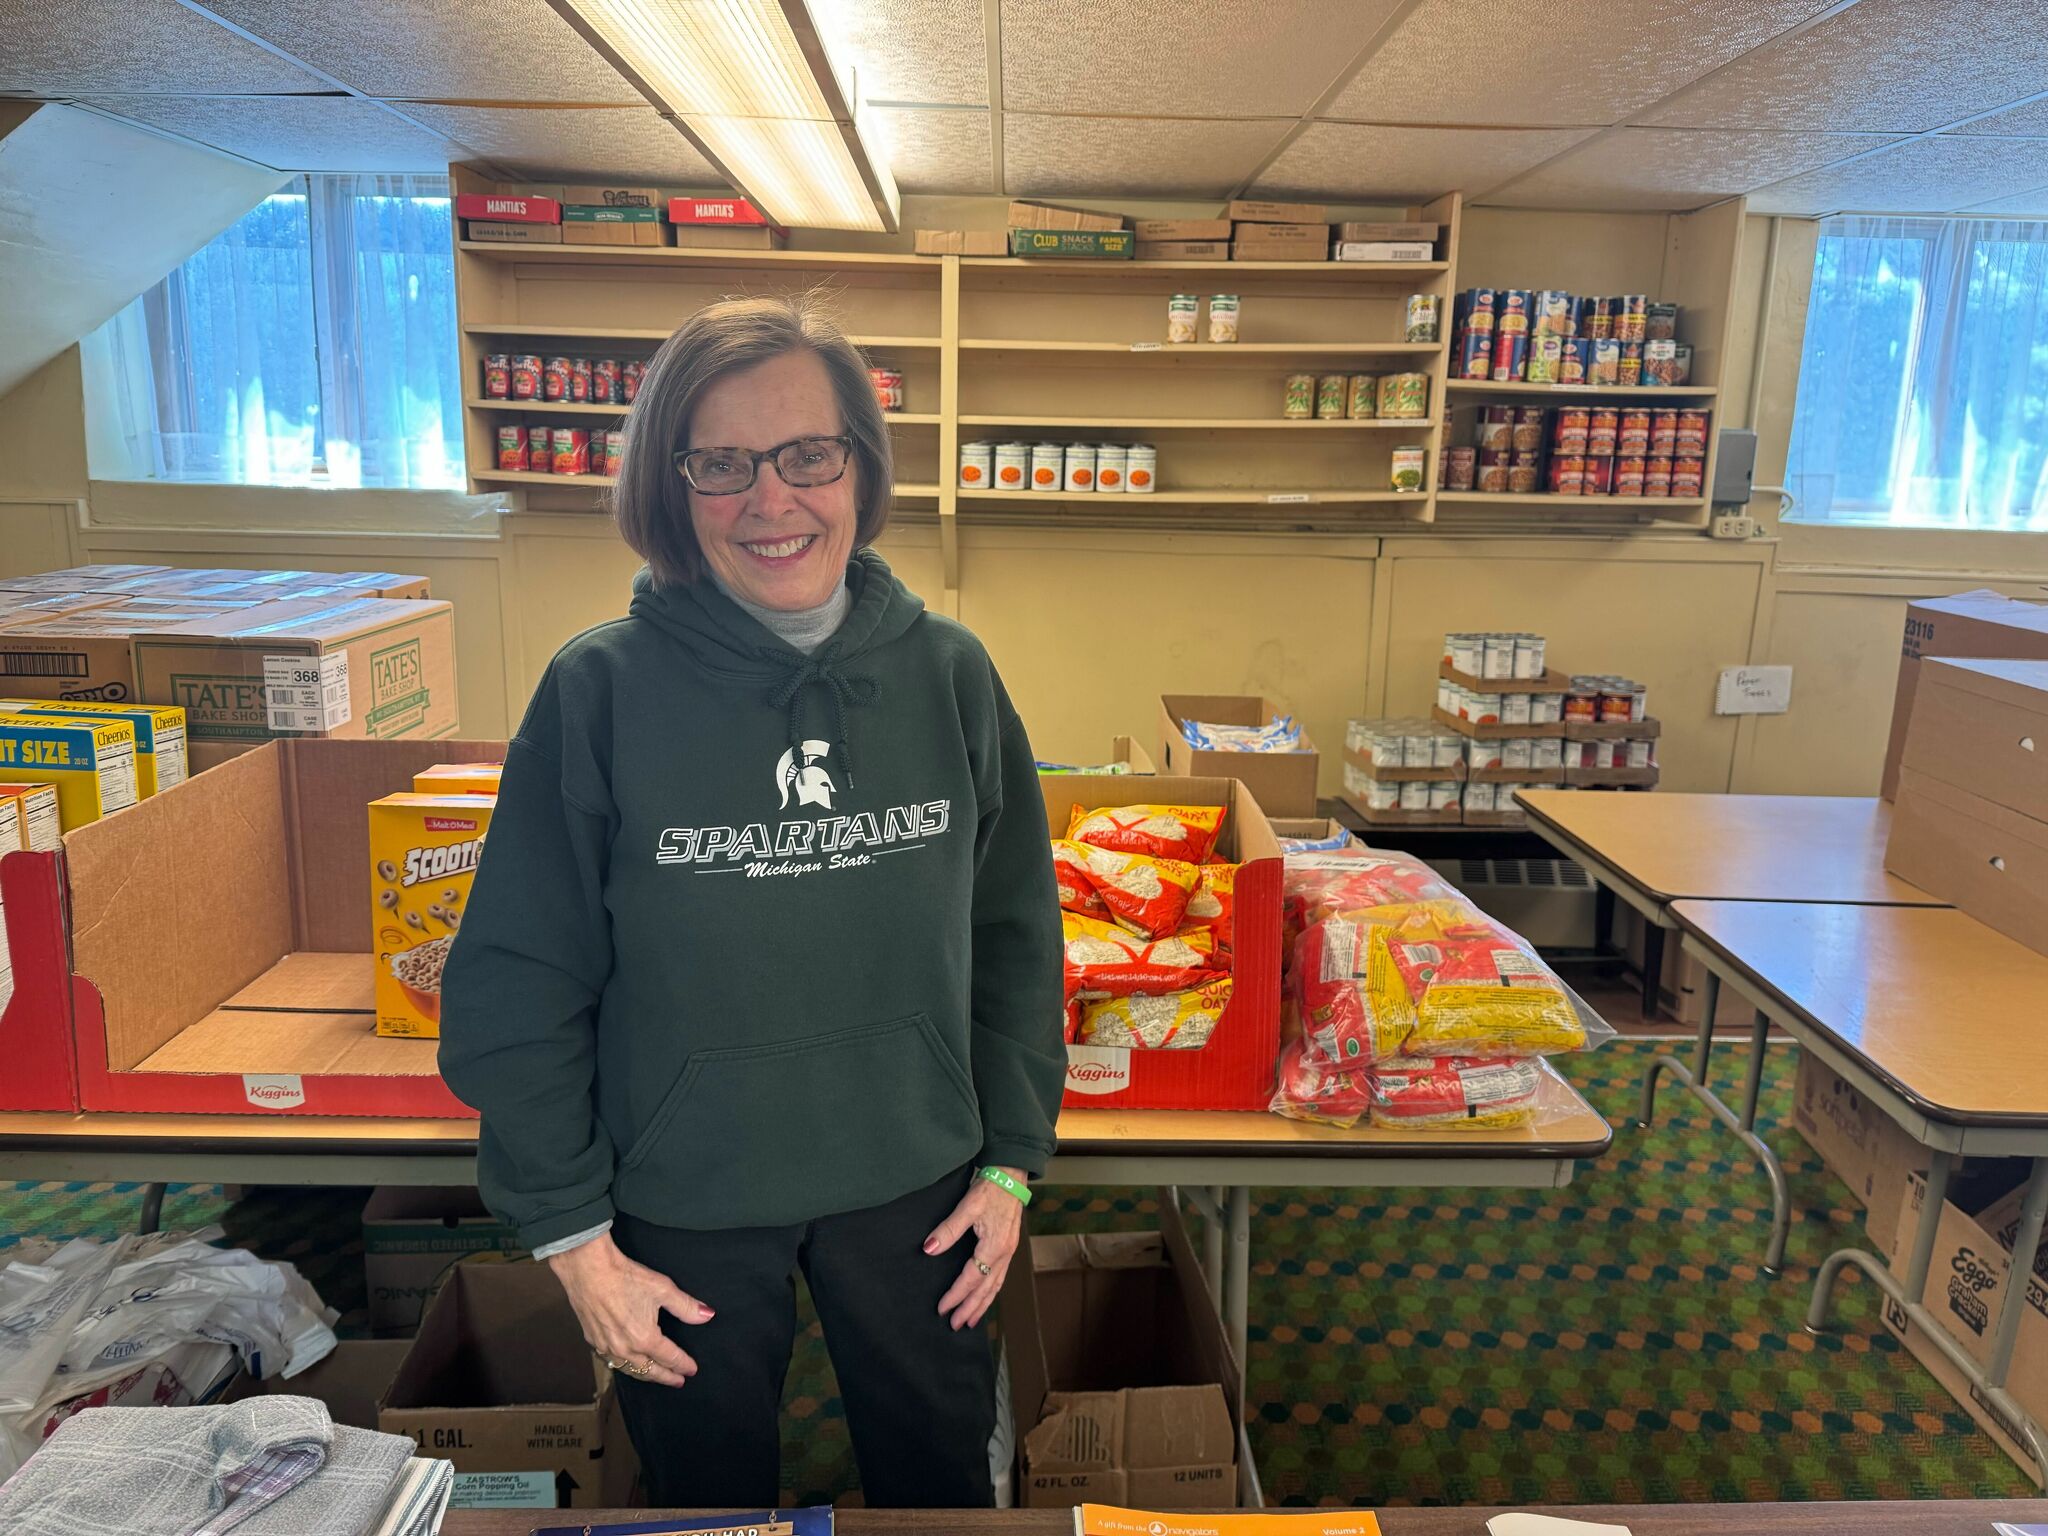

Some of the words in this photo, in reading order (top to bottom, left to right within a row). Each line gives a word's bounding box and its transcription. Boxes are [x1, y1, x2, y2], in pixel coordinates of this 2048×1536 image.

[486, 199, 527, 215] MANTIA'S
[695, 203, 735, 218] MANTIA'S
[1033, 233, 1059, 247] CLUB
[1062, 234, 1094, 243] SNACK
[1099, 236, 1128, 244] FAMILY
[1905, 618, 1935, 641] 23116
[335, 664, 347, 677] 368
[374, 649, 418, 688] TATE'S
[294, 670, 319, 683] 368
[179, 682, 268, 710] TATE'S
[381, 685, 397, 700] BAKE
[399, 678, 415, 691] SHOP
[154, 714, 183, 730] Cheerios
[192, 709, 228, 721] BAKE
[231, 708, 267, 722] SHOP
[97, 727, 131, 747] Cheerios
[22, 740, 70, 765] SIZE
[25, 794, 43, 804] Nutrition
[655, 799, 951, 865] SPARTANS
[743, 861, 823, 879] Michigan
[828, 853, 872, 869] State
[1195, 984, 1232, 996] QUIC
[1200, 998, 1227, 1010] OAT
[1066, 1062, 1126, 1082] Kiggins
[250, 1085, 301, 1100] Kiggins
[373, 1239, 429, 1251] ORGANIC
[1951, 1247, 1998, 1293] Eggo
[534, 1424, 575, 1436] HANDLE
[433, 1428, 473, 1449] GAL.
[526, 1437, 553, 1448] WITH
[556, 1437, 583, 1448] CARE
[466, 1475, 521, 1484] ZASTROW'S
[1174, 1471, 1186, 1482] 12
[1188, 1469, 1223, 1481] UNITS
[479, 1482, 515, 1491] Popping
[517, 1481, 530, 1489] Oil
[1034, 1477, 1047, 1489] 42
[1104, 1520, 1116, 1529] gift
[1117, 1521, 1135, 1531] from
[1322, 1527, 1358, 1535] Volume
